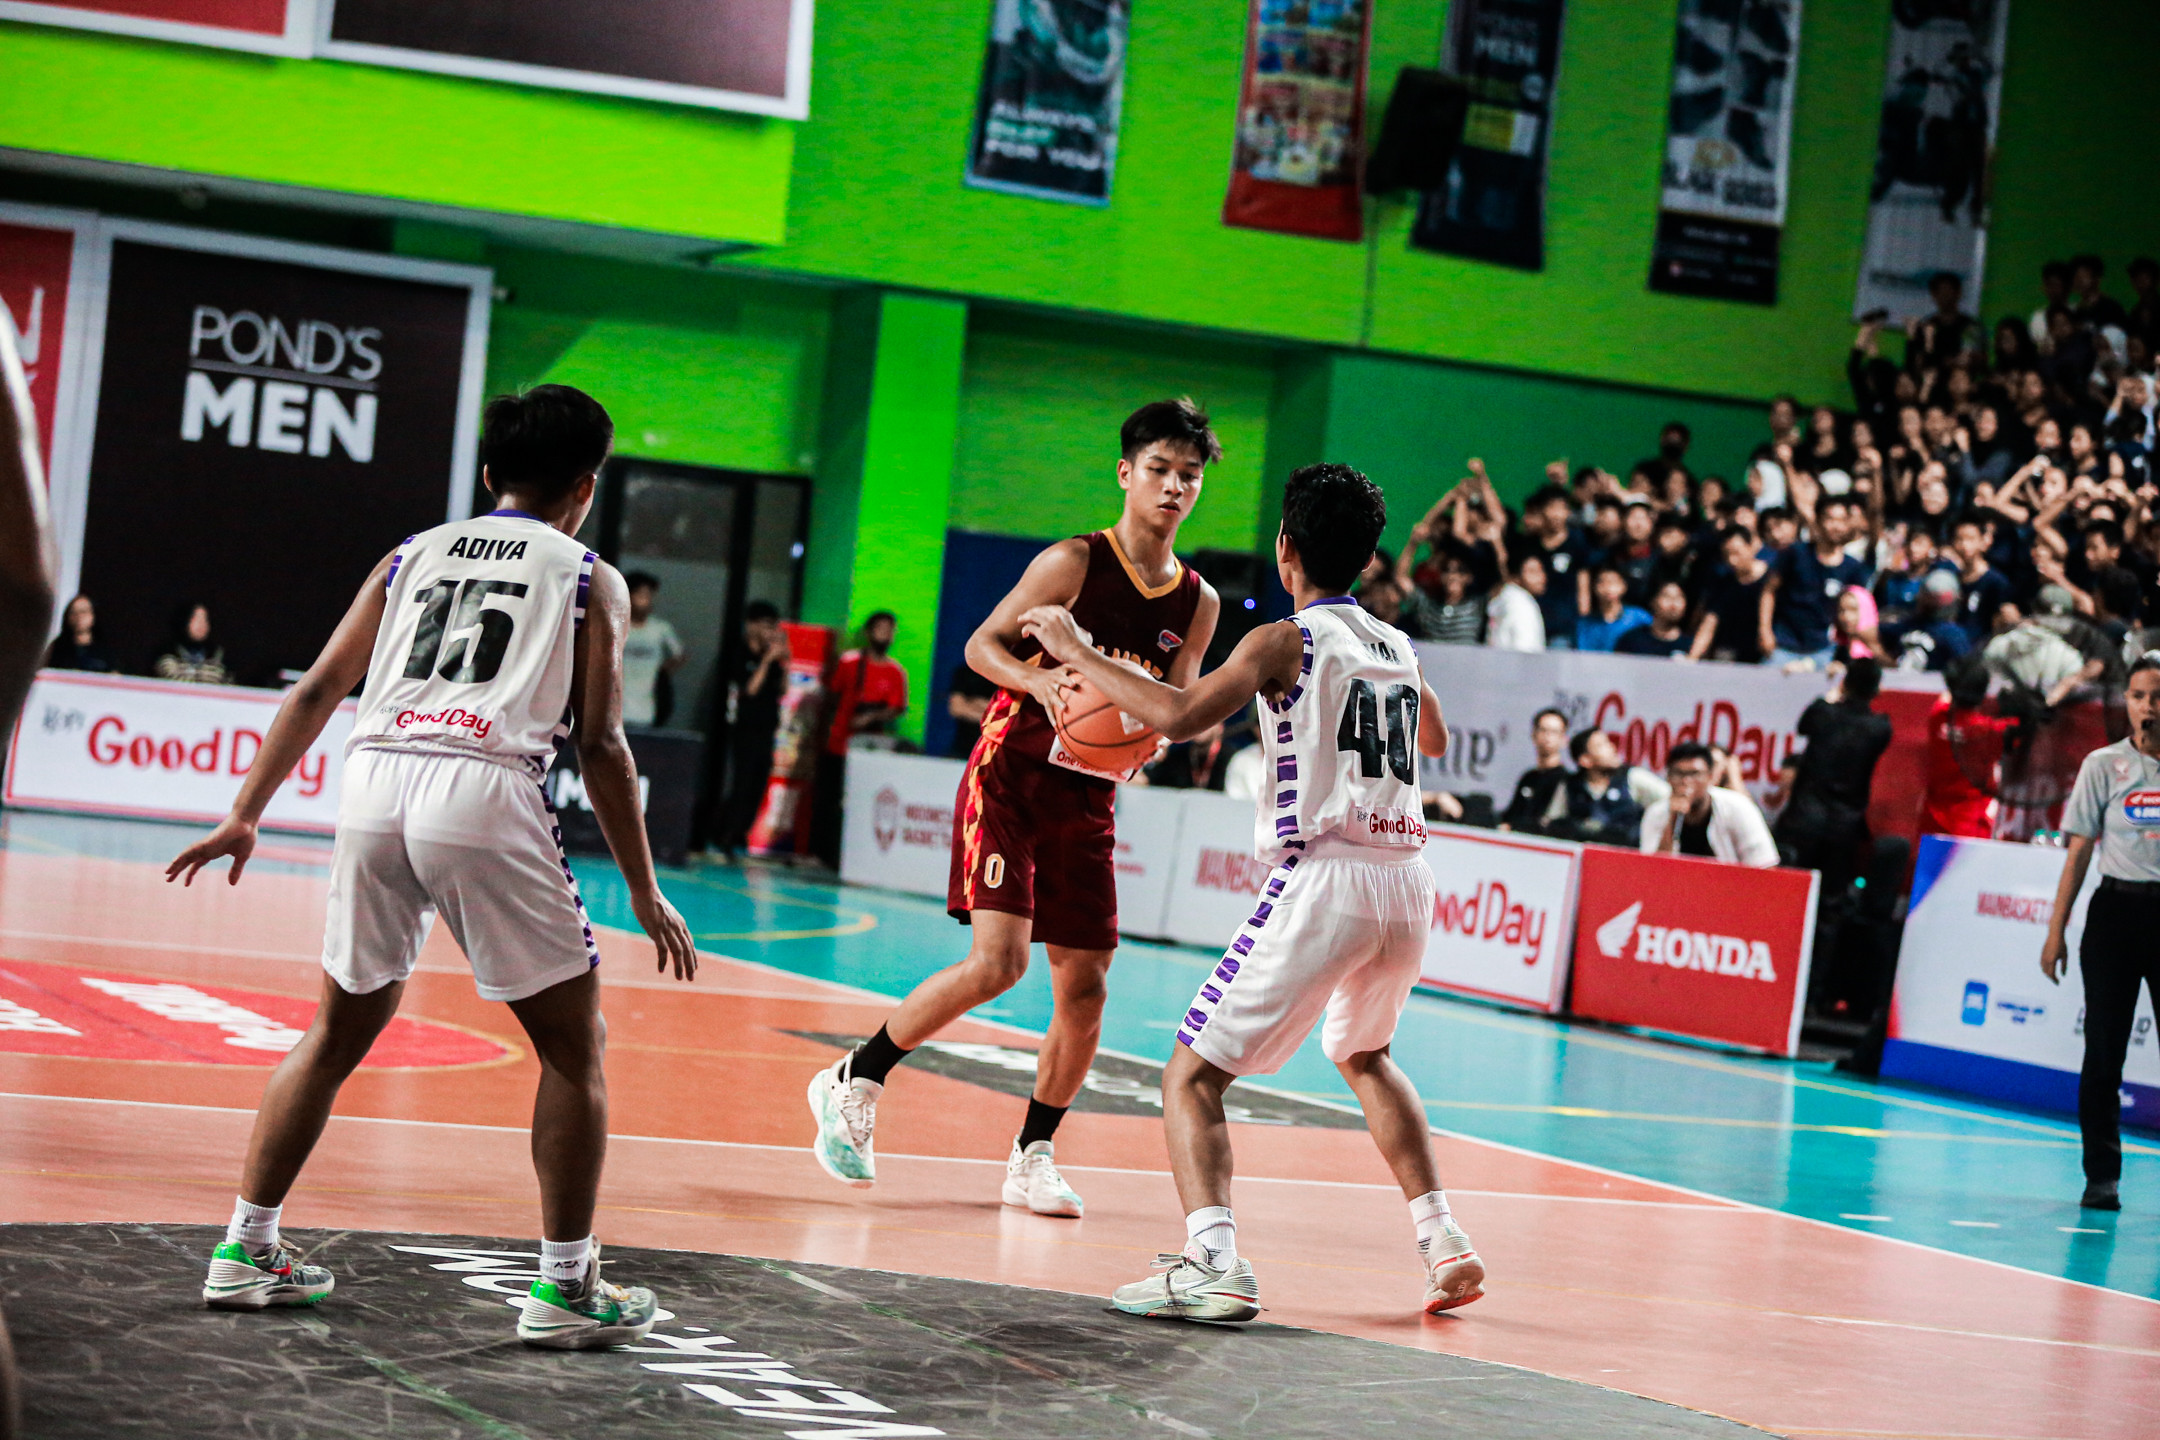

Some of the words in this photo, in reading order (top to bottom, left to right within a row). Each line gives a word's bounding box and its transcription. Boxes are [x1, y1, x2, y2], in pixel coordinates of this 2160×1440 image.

[190, 305, 383, 381] POND'S
[180, 371, 378, 463] MEN
[447, 537, 528, 560] ADIVA
[403, 579, 529, 683] 15
[1337, 678, 1418, 785] 40
[1635, 924, 1777, 983] HONDA
